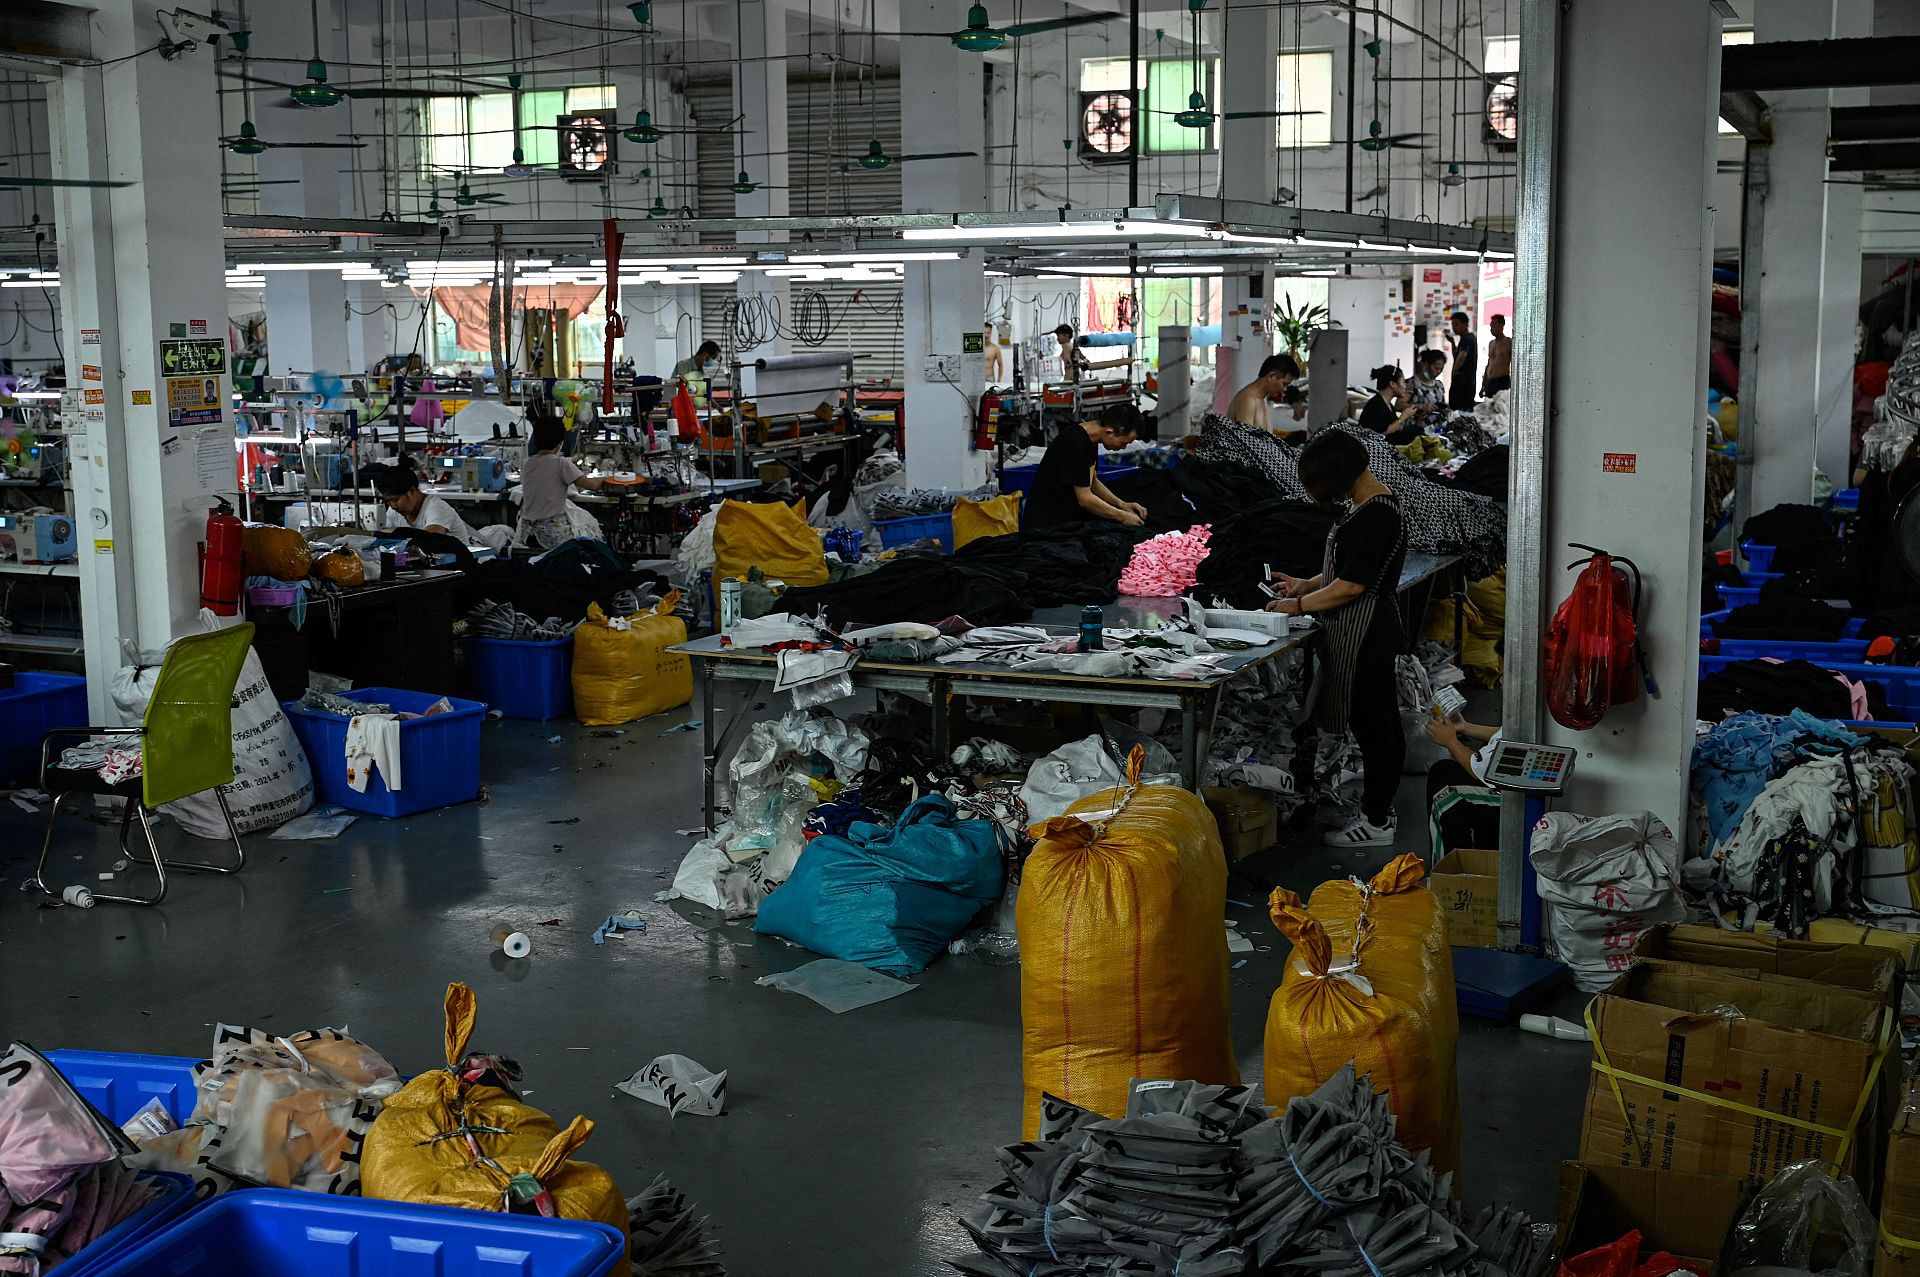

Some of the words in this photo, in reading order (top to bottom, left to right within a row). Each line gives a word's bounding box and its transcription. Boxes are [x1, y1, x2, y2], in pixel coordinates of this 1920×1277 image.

[182, 359, 206, 370] EXIT
[1792, 1072, 1802, 1091] used
[1809, 1079, 1821, 1109] sample
[1748, 1144, 1759, 1172] number
[1759, 1067, 1769, 1092] please
